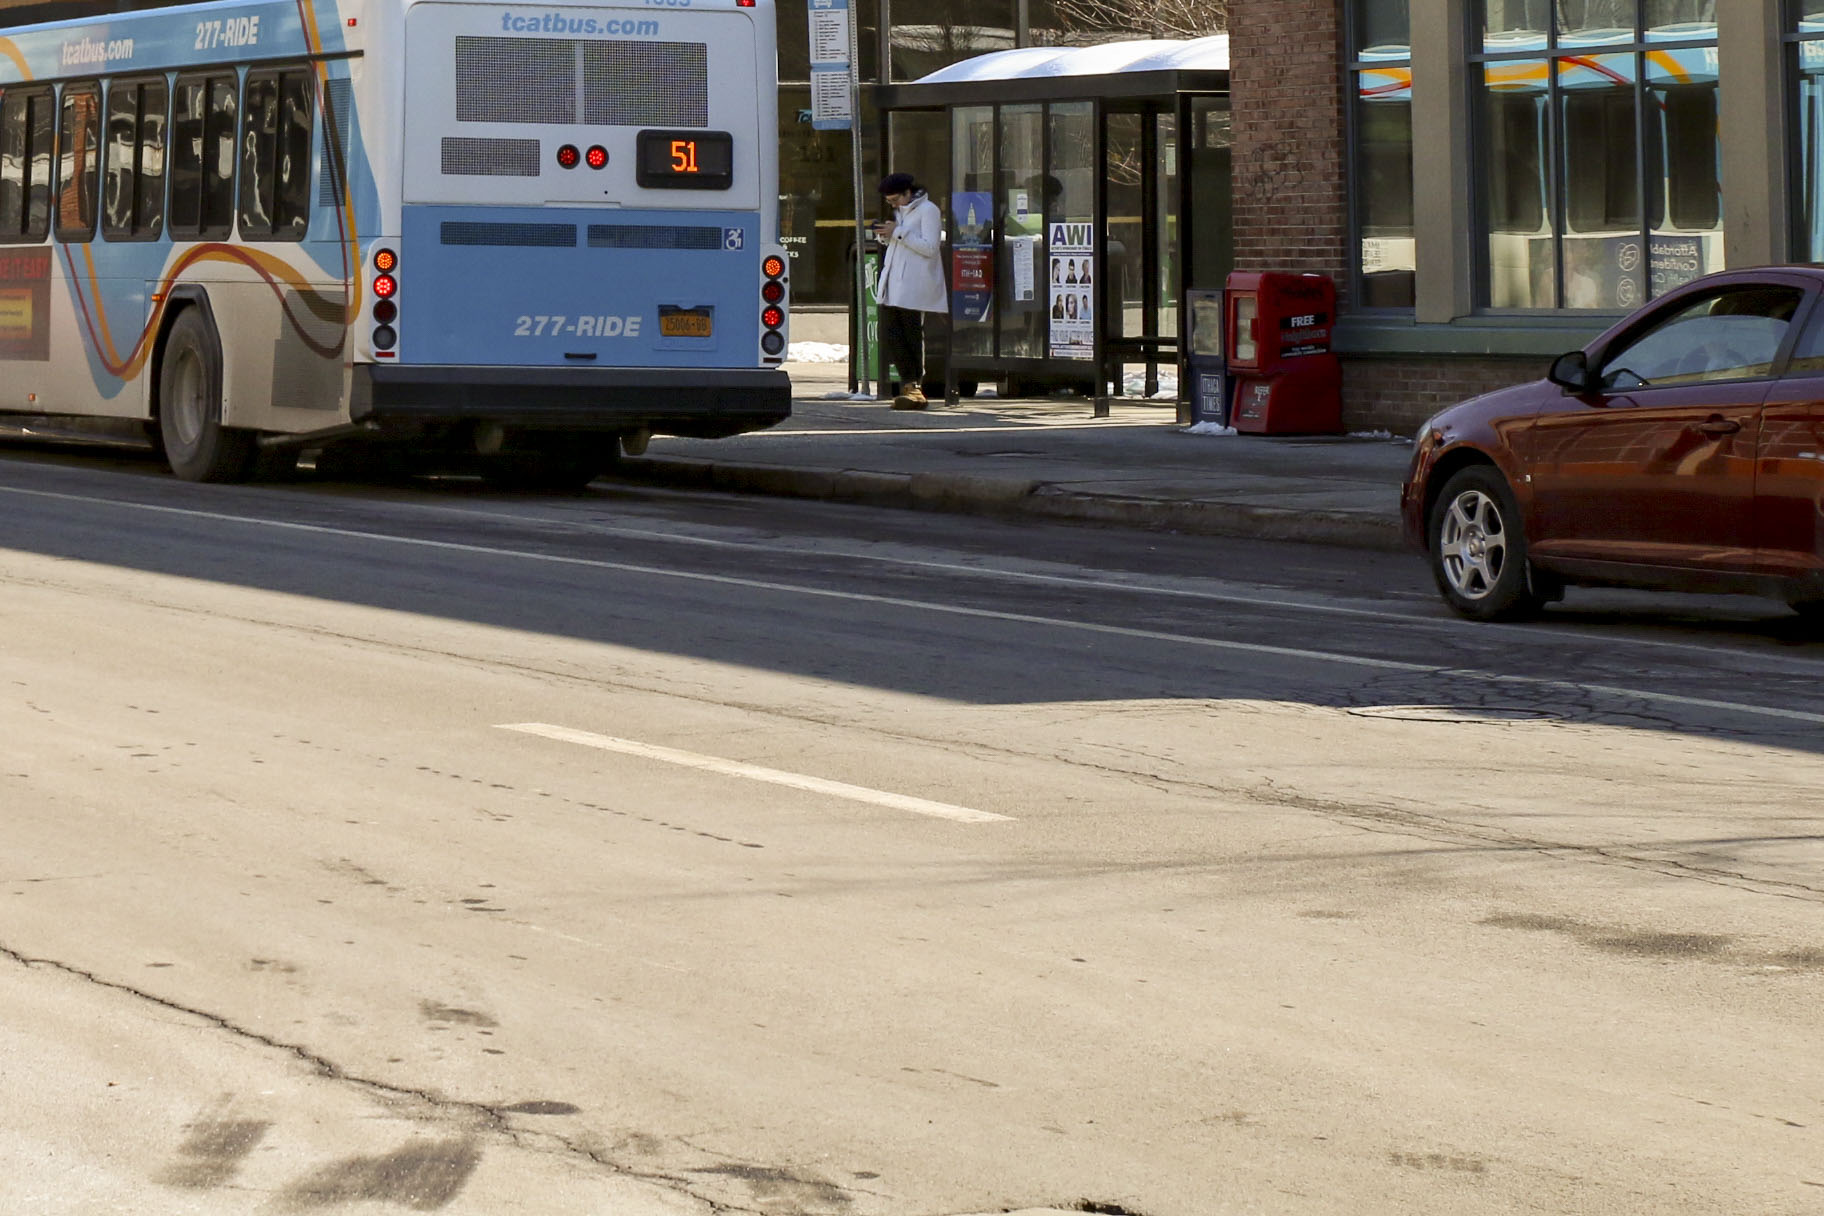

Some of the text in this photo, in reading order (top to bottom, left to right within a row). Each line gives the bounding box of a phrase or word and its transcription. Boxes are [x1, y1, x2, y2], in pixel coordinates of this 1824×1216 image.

[194, 16, 260, 51] 277-RIDE
[501, 12, 659, 36] tcatbus.com
[62, 37, 134, 65] tcatbus.com
[670, 140, 699, 172] 51
[779, 236, 807, 244] COFFEE
[1052, 225, 1092, 245] AWI
[514, 316, 643, 337] 277-RIDE
[1291, 314, 1315, 327] FREE
[1202, 378, 1219, 393] ITHACA
[1202, 396, 1221, 412] TIMES
